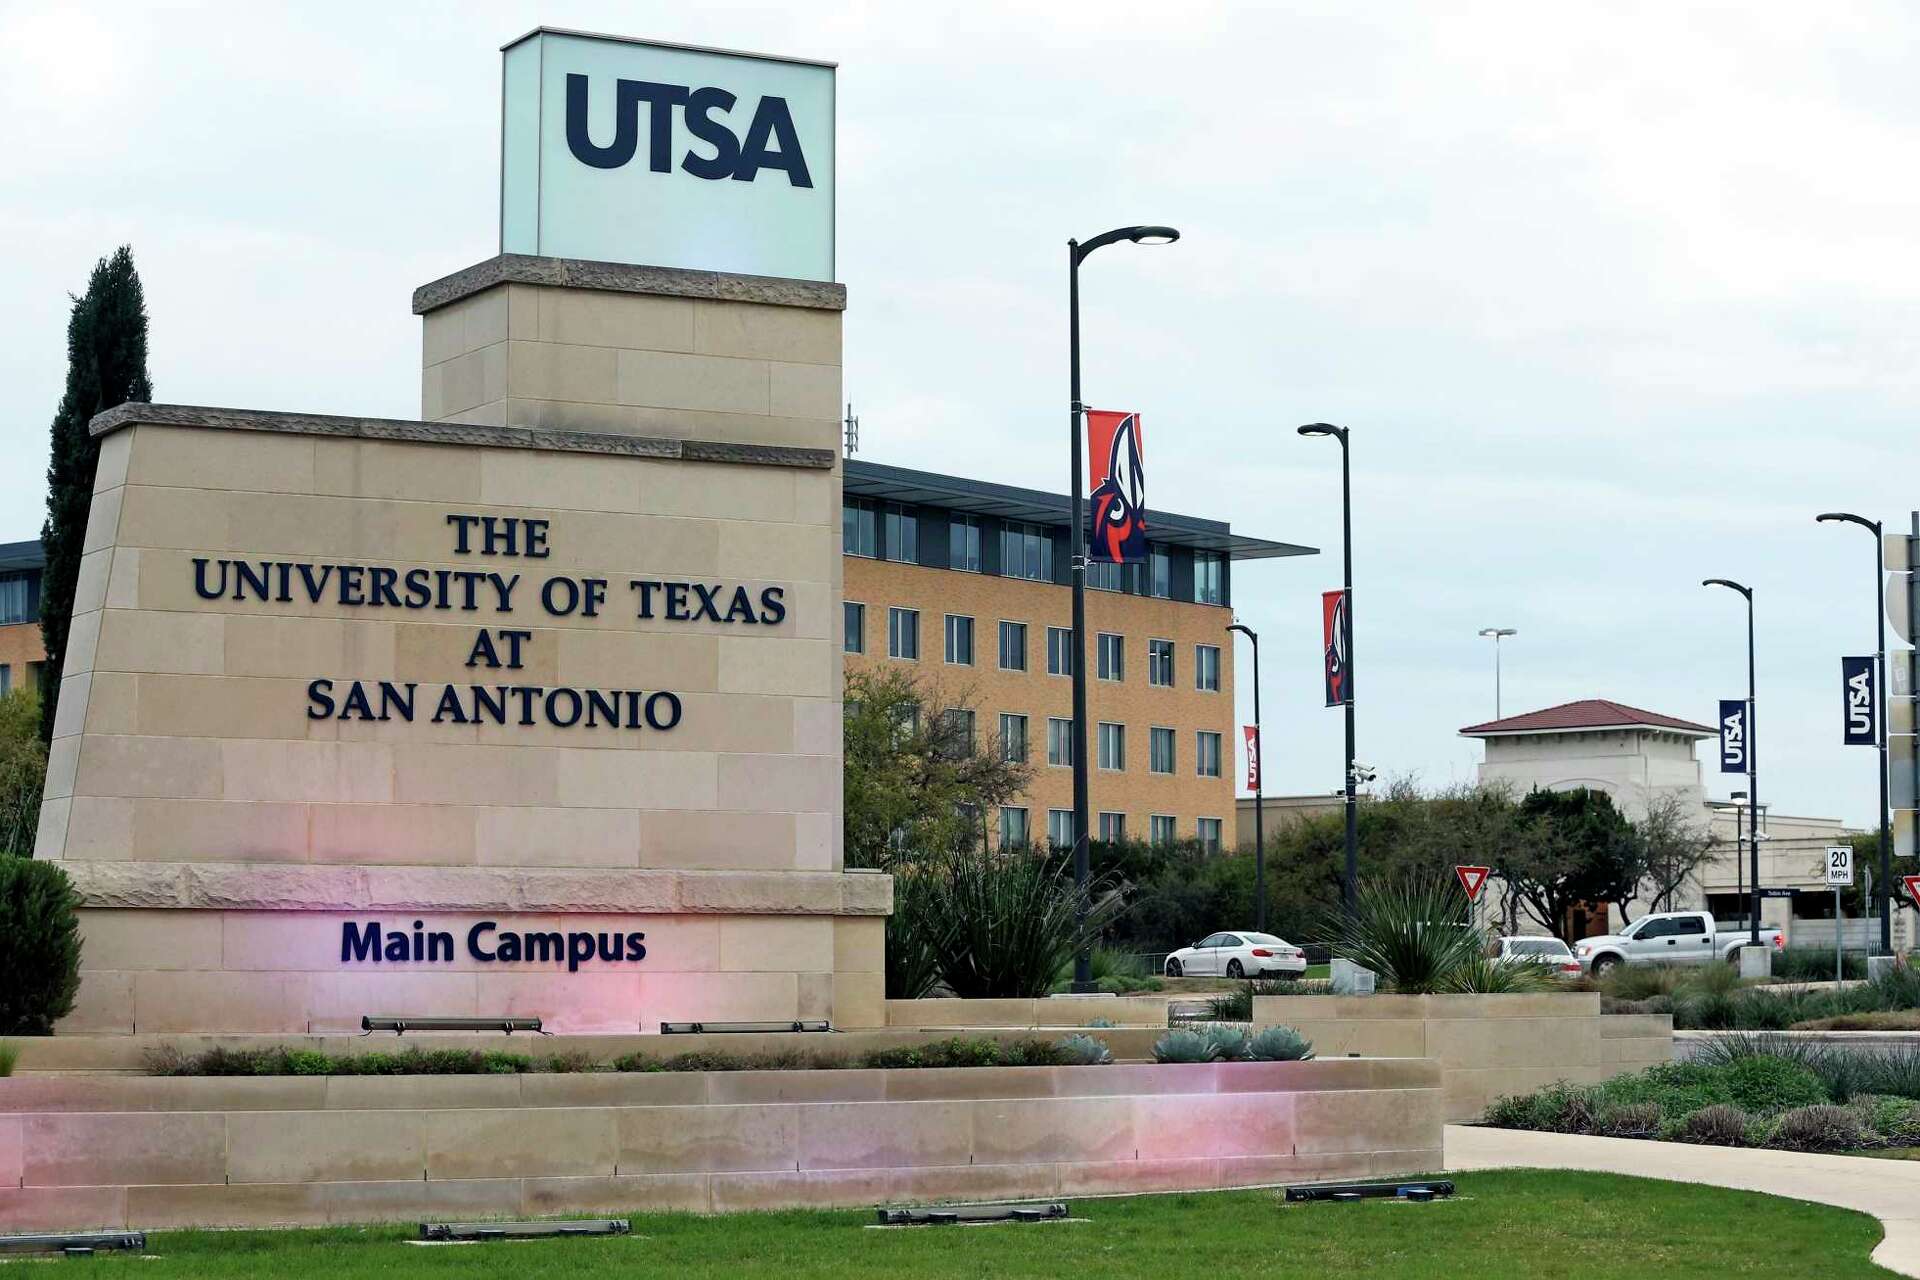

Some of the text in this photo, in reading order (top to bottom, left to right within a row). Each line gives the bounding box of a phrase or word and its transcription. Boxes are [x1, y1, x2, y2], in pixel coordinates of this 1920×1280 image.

[566, 73, 814, 189] UTSA
[446, 514, 550, 559] THE
[191, 557, 787, 626] UNIVERSITY OF TEXAS
[464, 628, 532, 671] AT
[306, 679, 683, 732] SAN ANTONIO
[1849, 668, 1871, 734] UTSA
[1724, 710, 1743, 764] UTSA
[1831, 851, 1848, 868] 20
[1831, 870, 1849, 880] MPH
[340, 920, 648, 973] Main Campus
